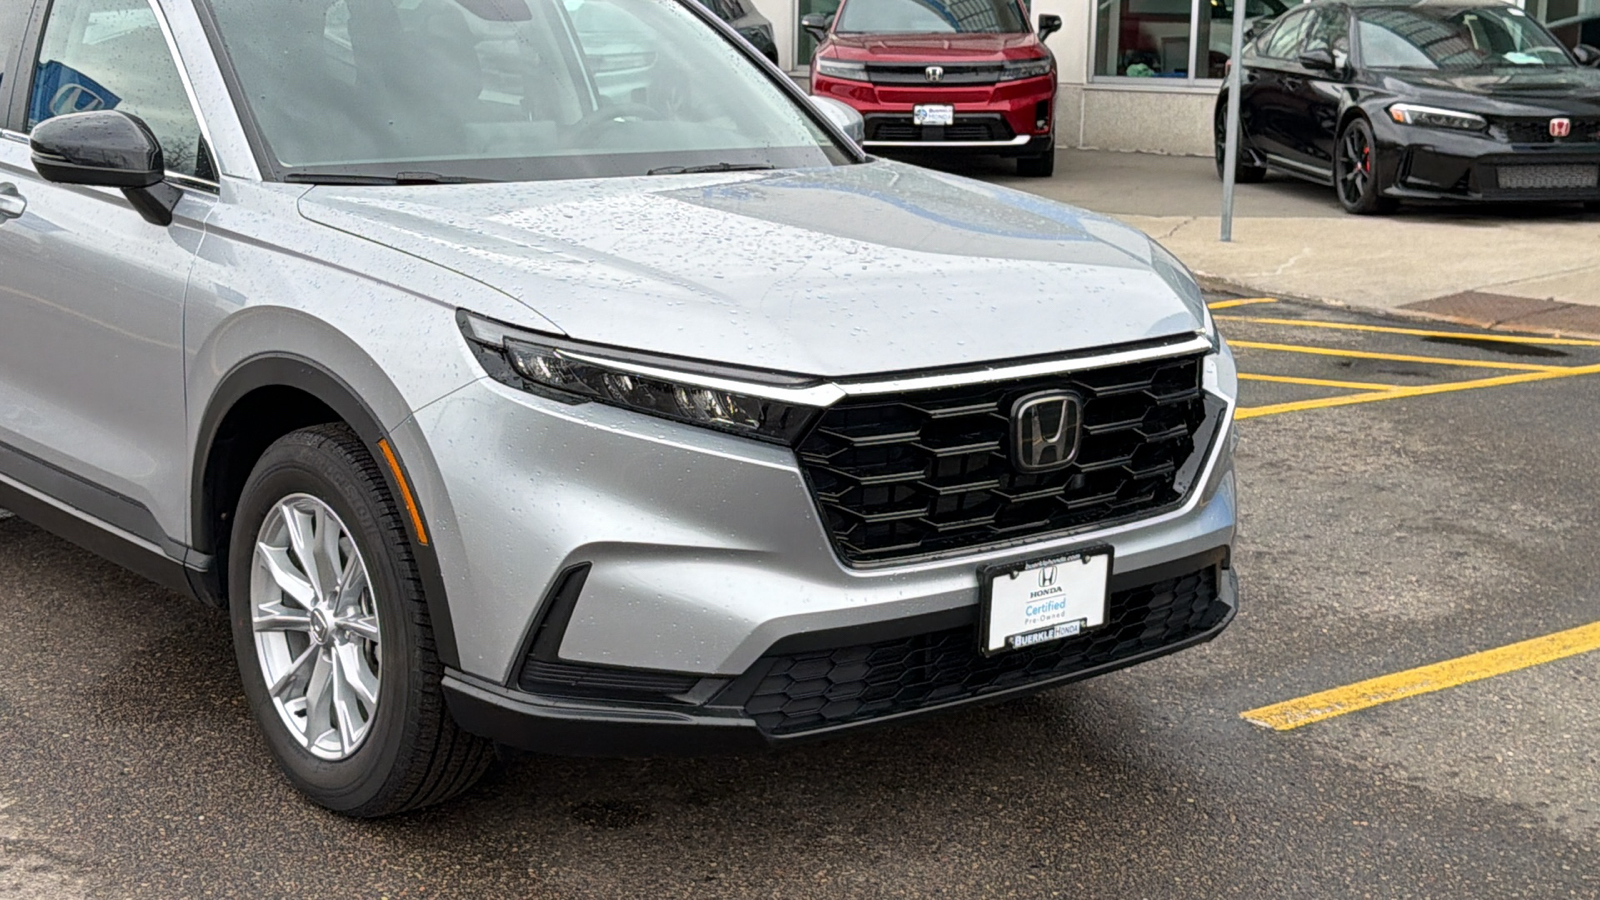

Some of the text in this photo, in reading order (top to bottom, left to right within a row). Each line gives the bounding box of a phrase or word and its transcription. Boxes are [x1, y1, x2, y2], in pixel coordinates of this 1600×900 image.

[1029, 586, 1063, 599] HONDA
[1025, 598, 1067, 616] Certified
[1024, 611, 1066, 625] Pre-Owned
[1014, 628, 1054, 648] BUERKLE
